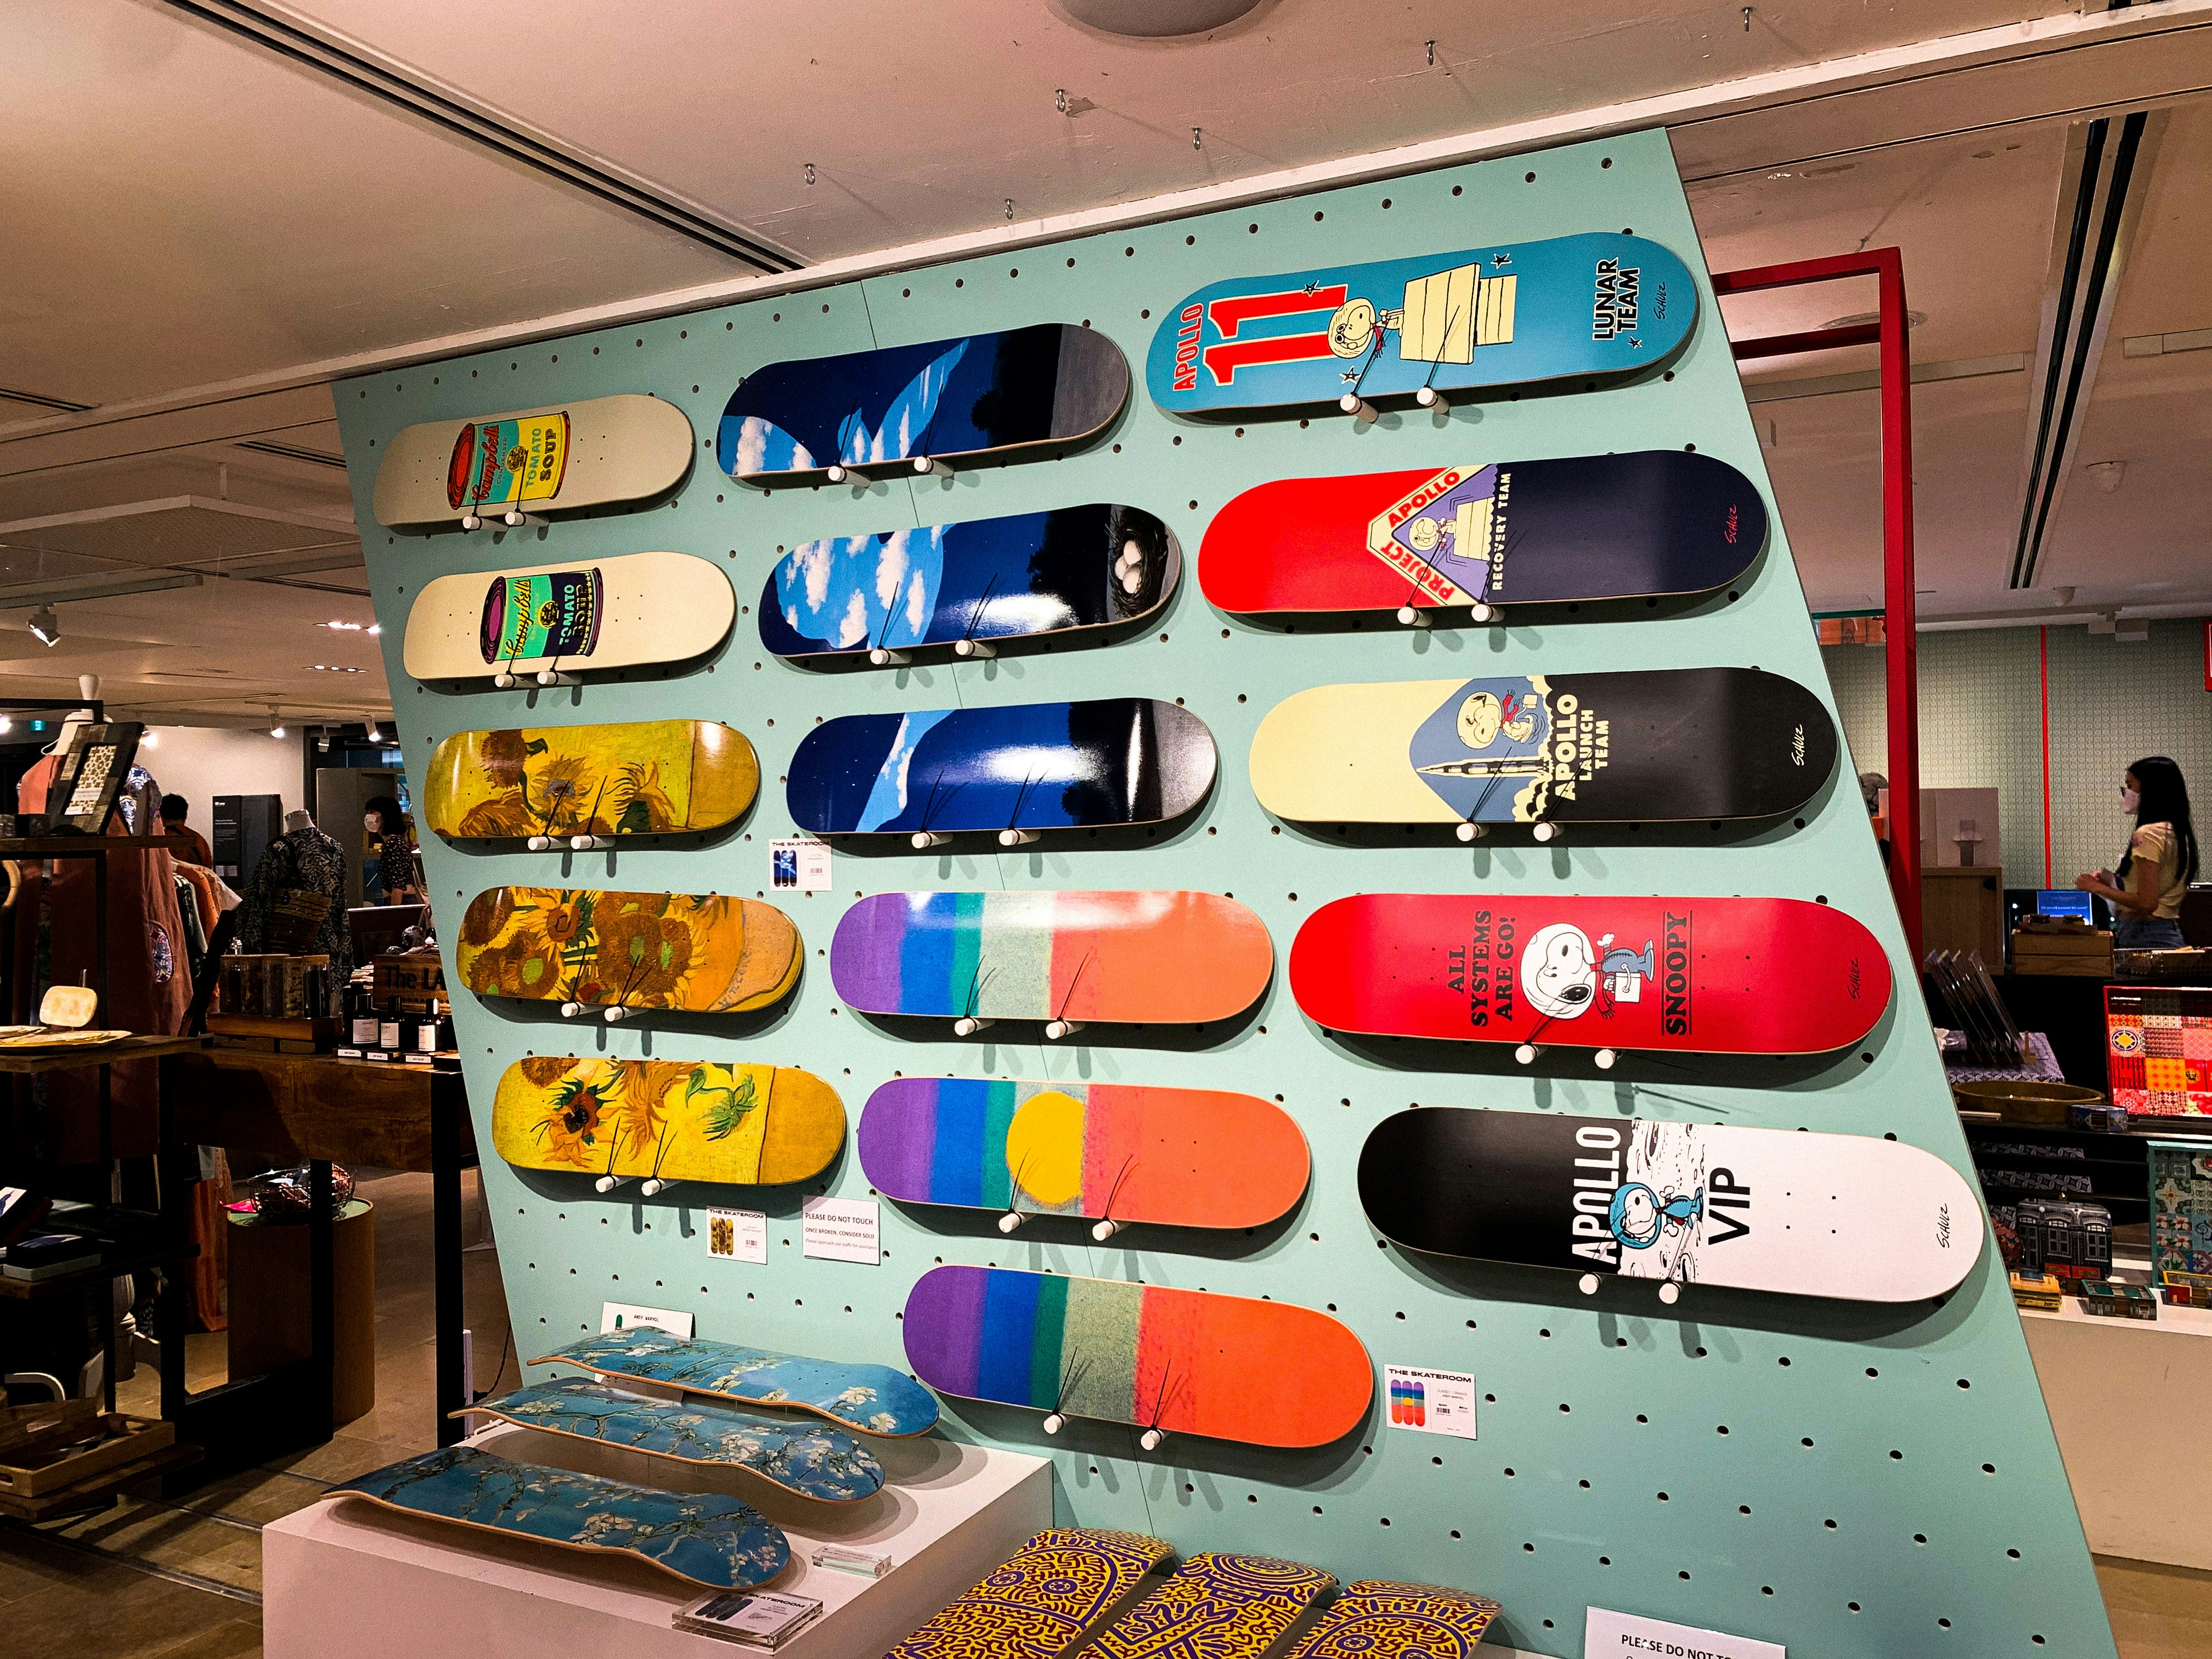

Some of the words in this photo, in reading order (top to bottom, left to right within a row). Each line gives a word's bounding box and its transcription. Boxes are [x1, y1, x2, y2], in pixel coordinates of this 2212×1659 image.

[1592, 257, 1618, 340] LUNAR
[1615, 268, 1640, 333] TEAM
[1654, 281, 1667, 320] SCHULZ
[1173, 303, 1204, 391] APOLLO
[1203, 284, 1348, 386] 11
[526, 428, 541, 486] TOMATO
[539, 428, 556, 482] SOUP
[1388, 472, 1460, 528] APOLLO
[1498, 473, 1511, 509] TEAM
[1724, 504, 1737, 544] SCHULZ
[1380, 540, 1455, 601] PROJECT
[1492, 515, 1506, 591] RECOVERY
[559, 584, 574, 645] TOMATO
[1555, 694, 1578, 801] APOLLO
[1579, 710, 1593, 781] LAUNCH
[1595, 720, 1609, 769] TEAM
[1791, 724, 1804, 766] SCHULZ
[1497, 917, 1515, 960] GO!
[385, 965, 416, 989] The
[1448, 945, 1466, 995] ALL
[1471, 911, 1491, 1027] SYSTEMS
[1495, 967, 1513, 1022] ARE
[1665, 911, 1687, 1036] SNOOPY
[1847, 957, 1860, 1000] SCHULZ
[805, 1212, 826, 1221] PLEASE
[1572, 1126, 1621, 1265] APOLLO
[1708, 1167, 1751, 1245] VIP
[1937, 1203, 1950, 1248] SCHULZ
[1411, 1371, 1471, 1383] SKATEROOM
[1666, 1644, 1684, 1656] DO
[1688, 1649, 1713, 1659] NOT
